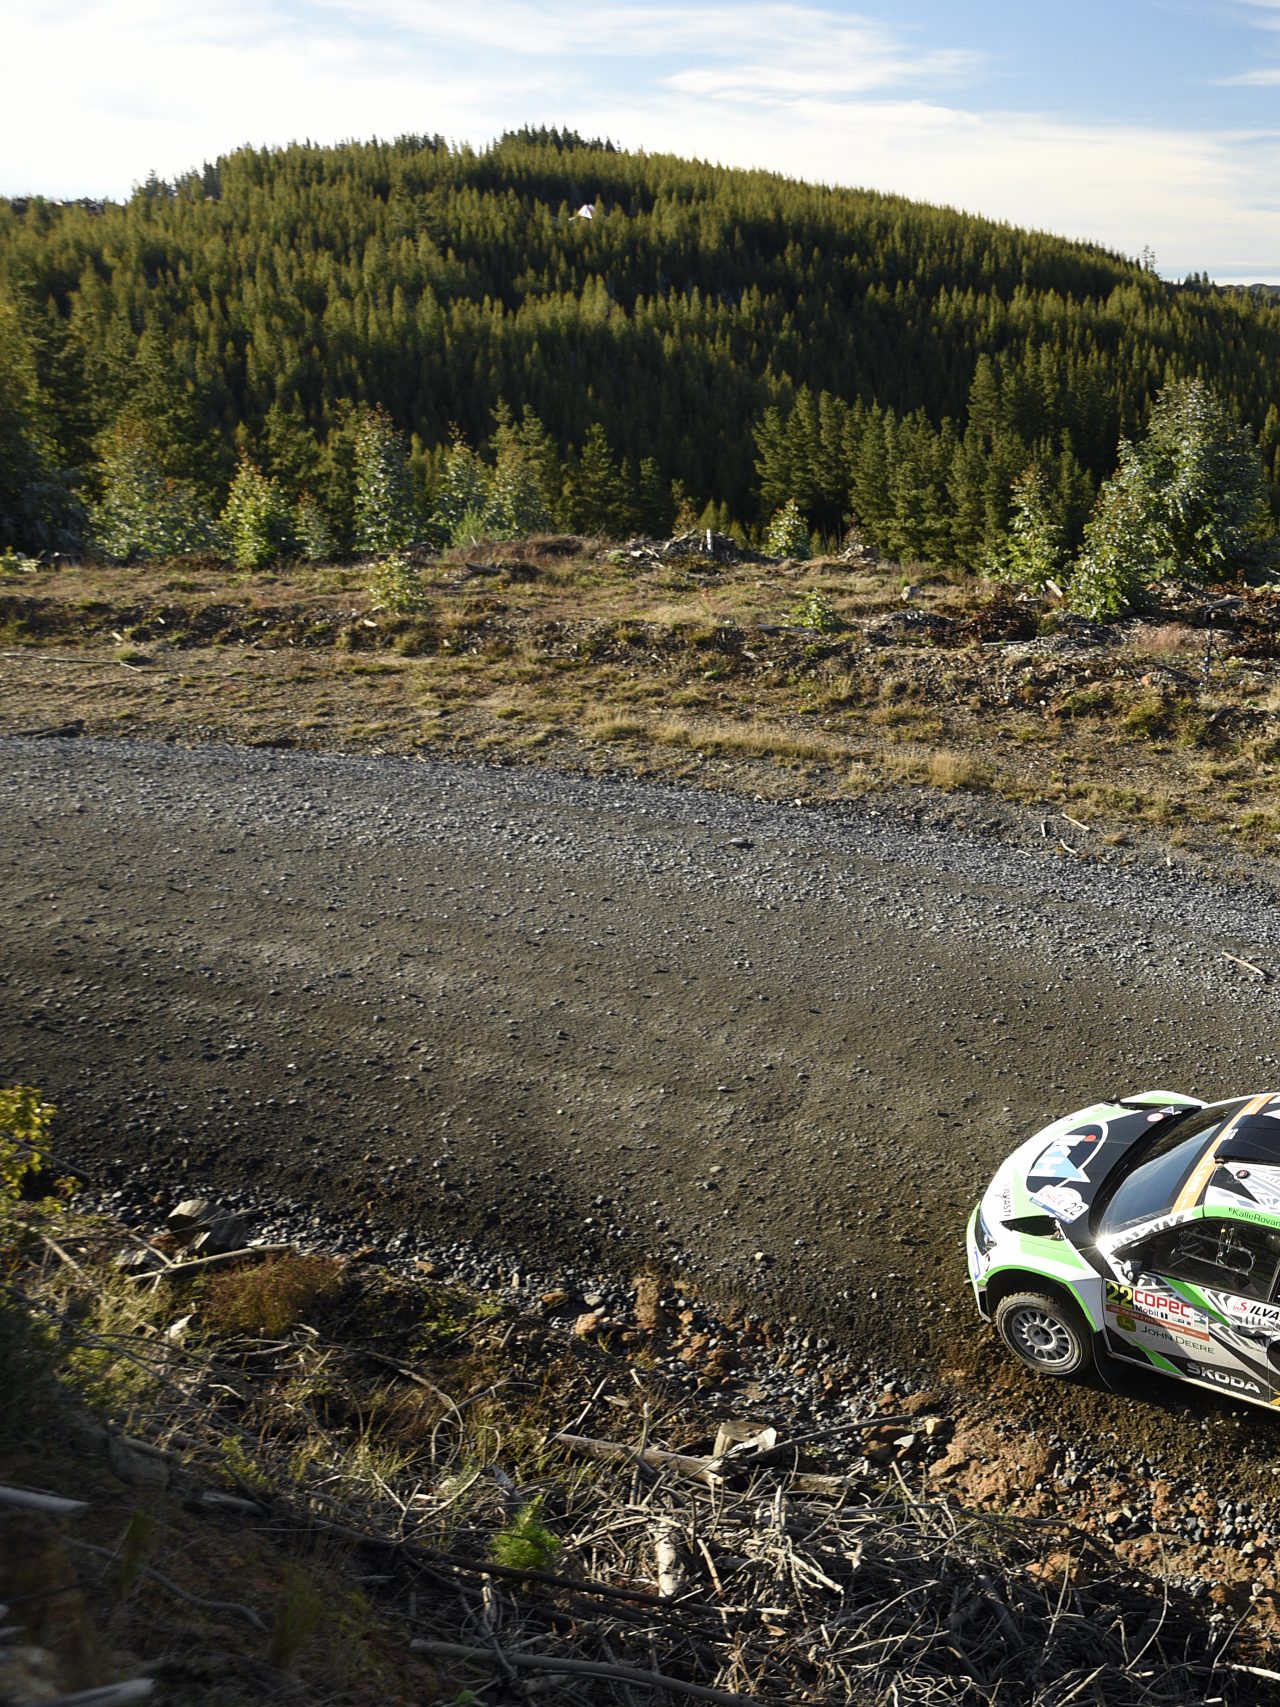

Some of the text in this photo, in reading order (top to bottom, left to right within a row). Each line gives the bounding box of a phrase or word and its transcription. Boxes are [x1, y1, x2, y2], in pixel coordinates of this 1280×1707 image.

[1063, 1202, 1083, 1216] 22
[1106, 1281, 1133, 1309] 22
[1141, 1326, 1173, 1341] JOHN
[1175, 1336, 1215, 1354] DEERE
[1187, 1362, 1261, 1394] ŠKODA
